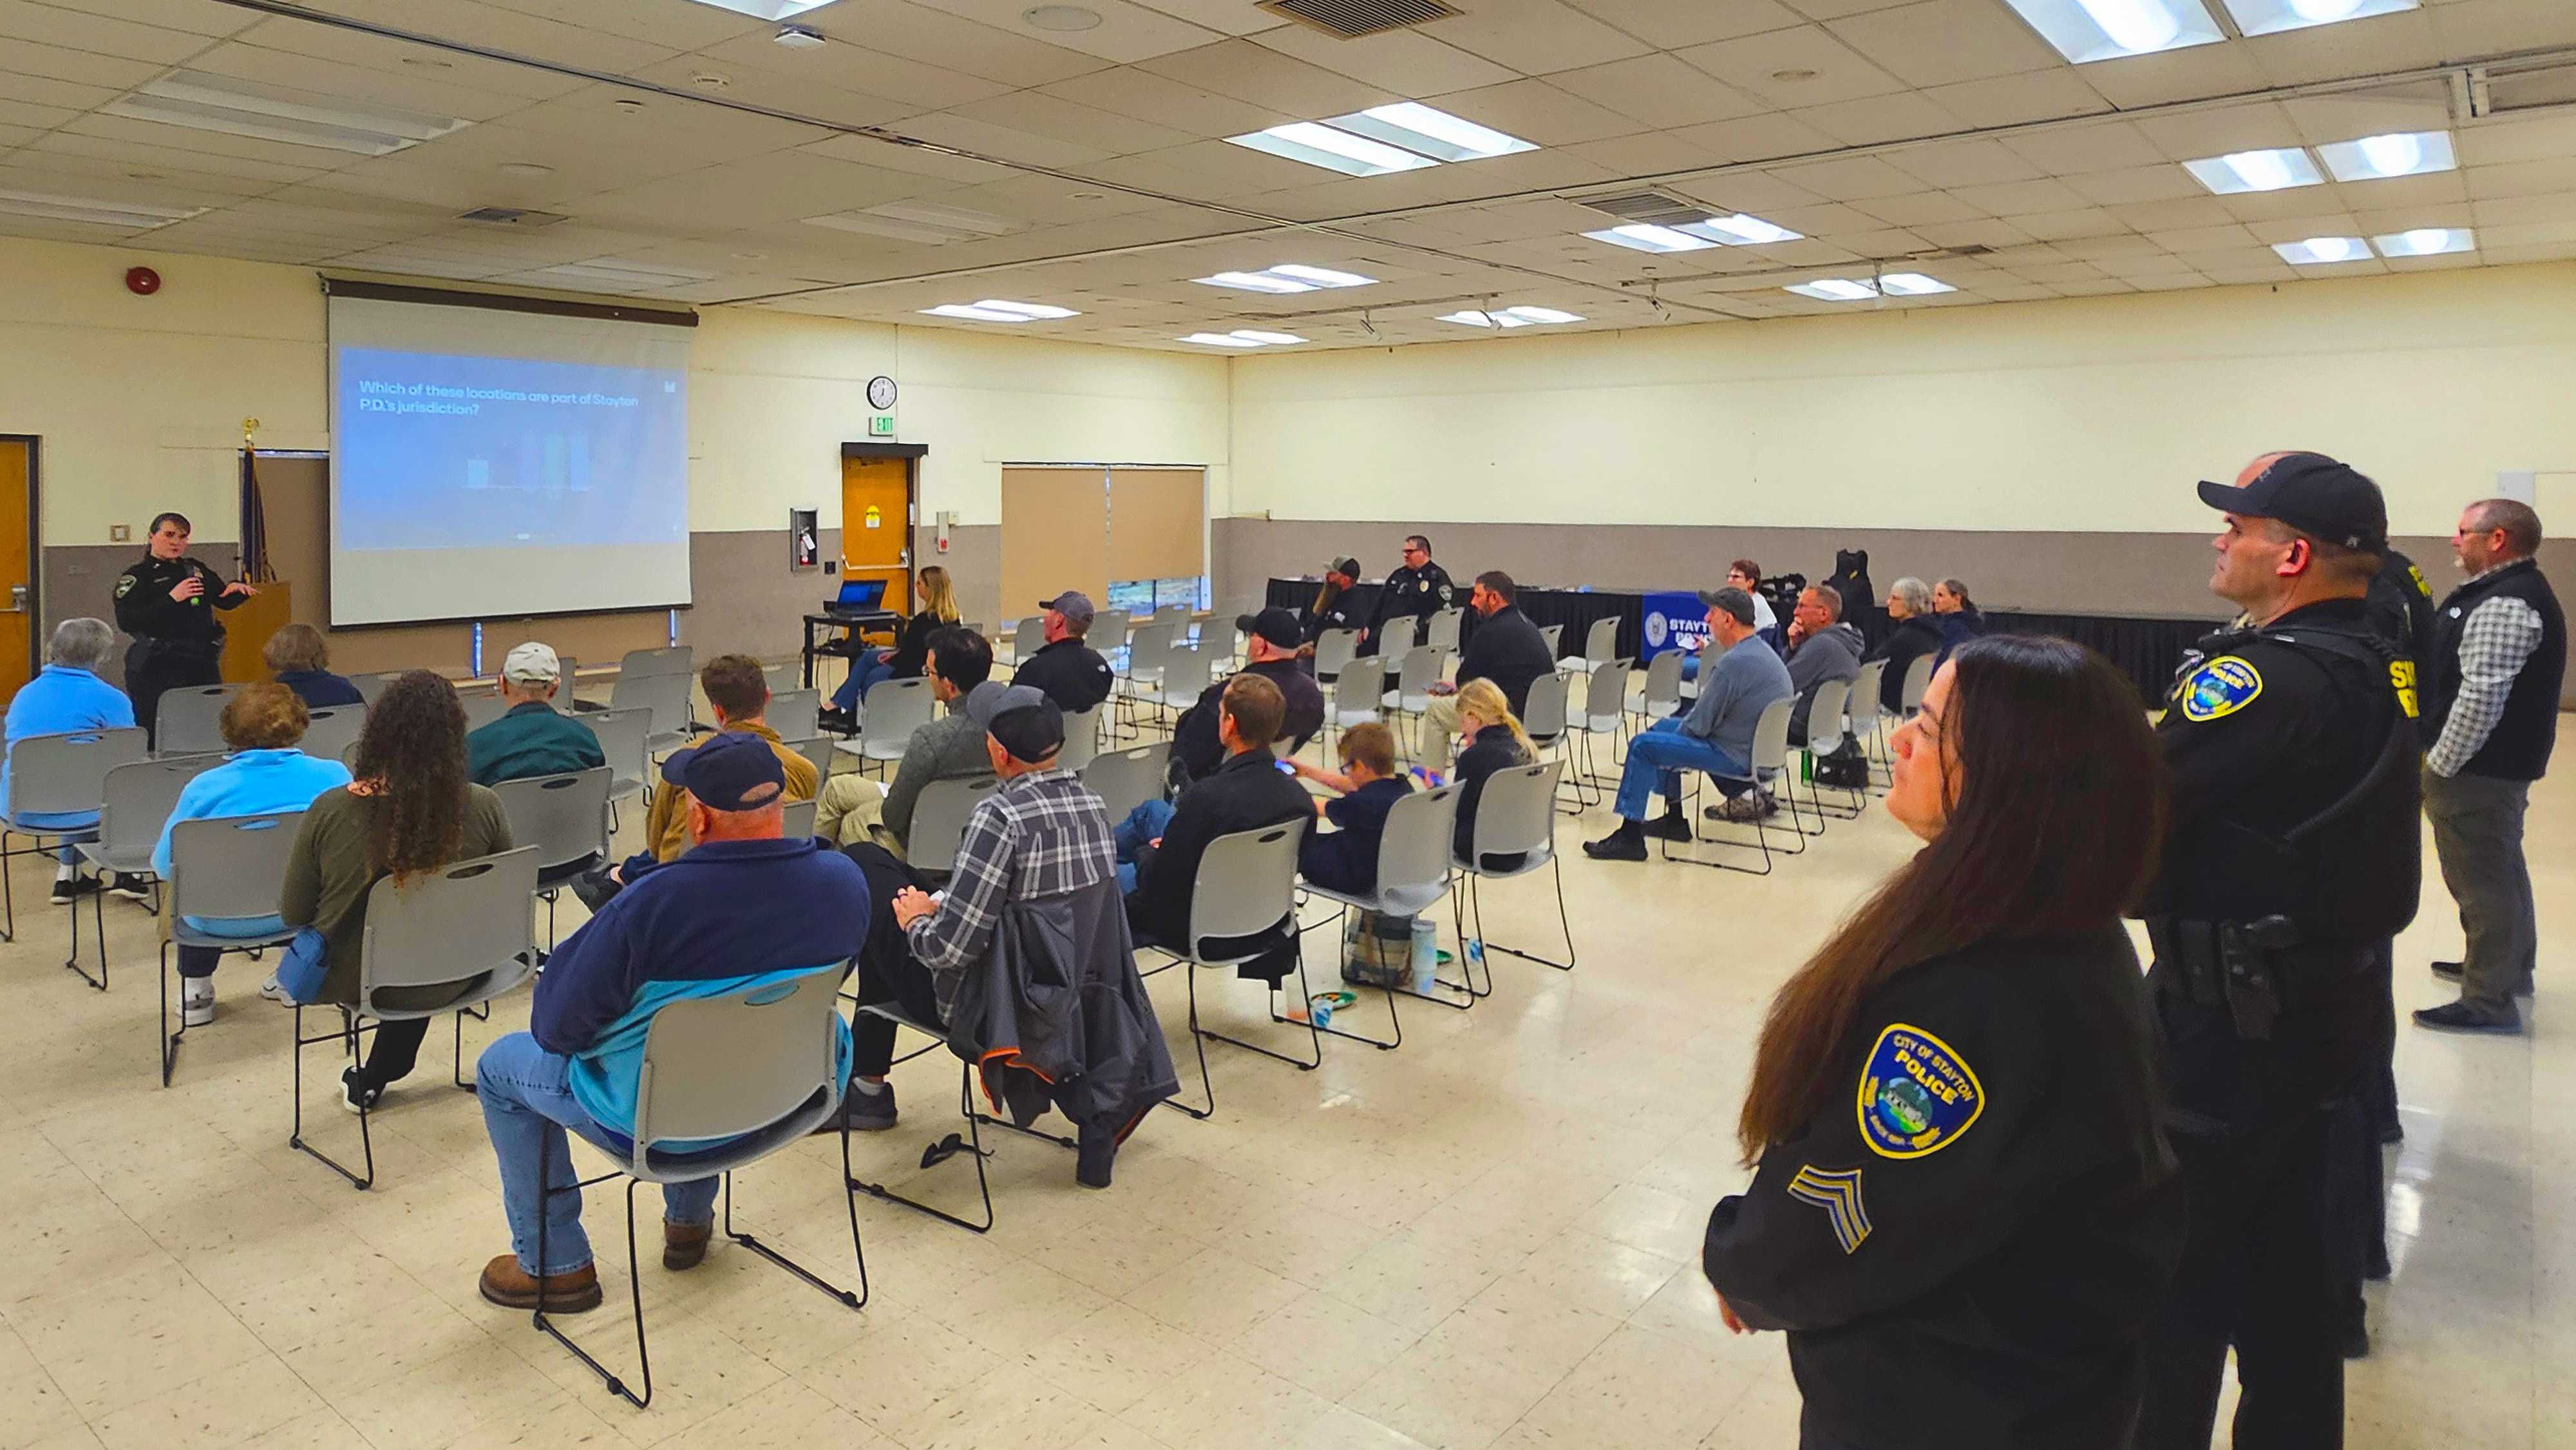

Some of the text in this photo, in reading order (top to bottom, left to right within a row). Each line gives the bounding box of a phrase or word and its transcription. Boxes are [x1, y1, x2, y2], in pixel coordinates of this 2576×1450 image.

[359, 381, 638, 408] Which of these locations are part of Stayton
[396, 400, 480, 415] jurisdiction?
[877, 417, 893, 431] EXIT
[1670, 619, 1708, 633] STAYT
[1893, 1034, 1975, 1102] CITY OF STAYTON
[1895, 1049, 1958, 1105] POLICE
